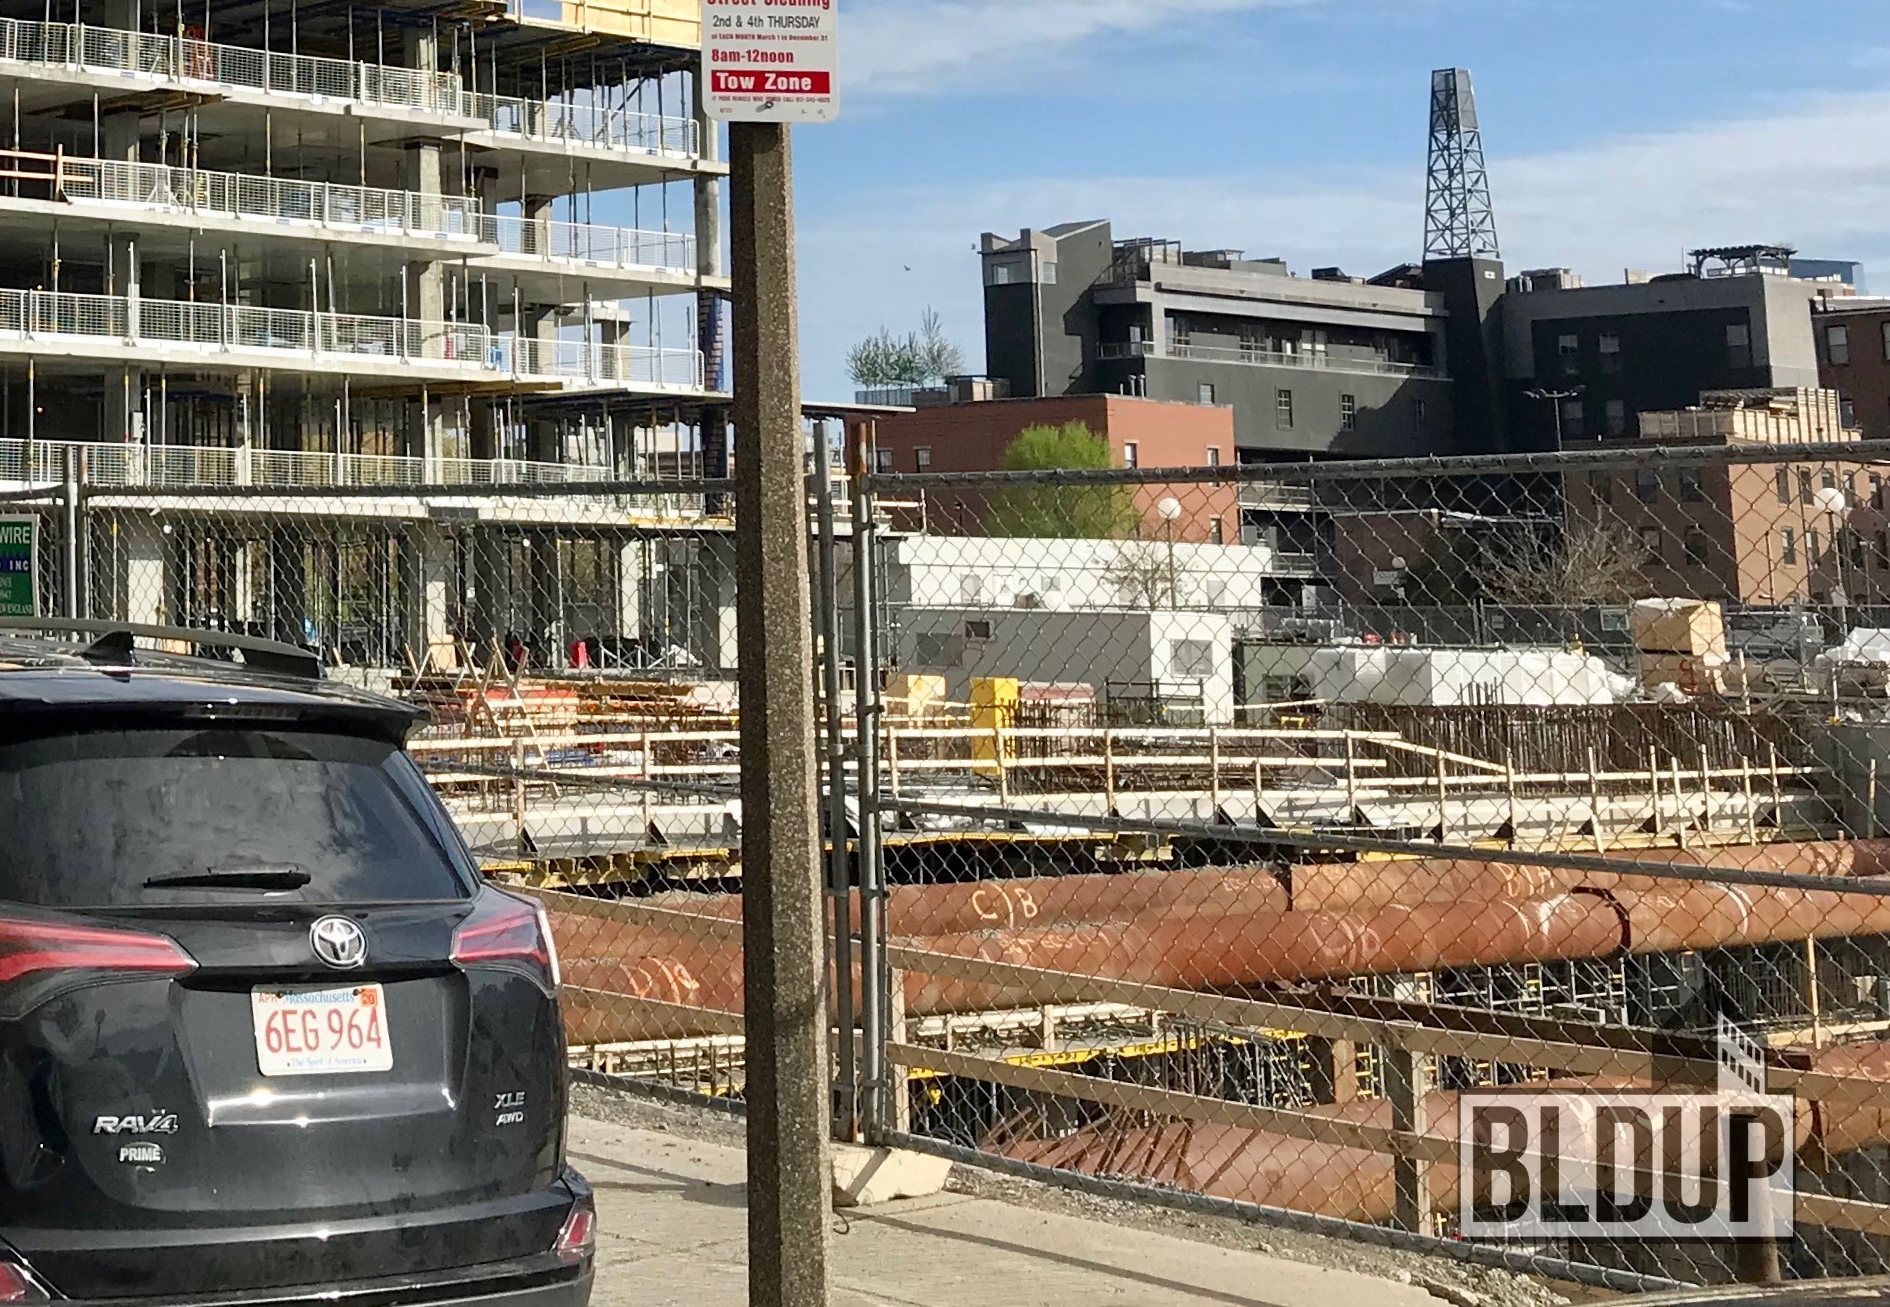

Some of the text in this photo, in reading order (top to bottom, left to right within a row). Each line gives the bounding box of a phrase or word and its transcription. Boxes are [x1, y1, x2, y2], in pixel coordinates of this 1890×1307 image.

[713, 14, 821, 29] 2nd & 4th THURSDAY
[711, 48, 794, 64] 8am-12noon
[716, 72, 812, 91] Tow Zone
[9, 560, 29, 571] INC
[284, 990, 355, 1004] Massachusetts
[265, 1007, 381, 1053] 6EG 964
[494, 1091, 525, 1109] XLE
[93, 1114, 178, 1134] RAV4
[496, 1111, 524, 1126] AWD
[119, 1147, 161, 1162] PRIME
